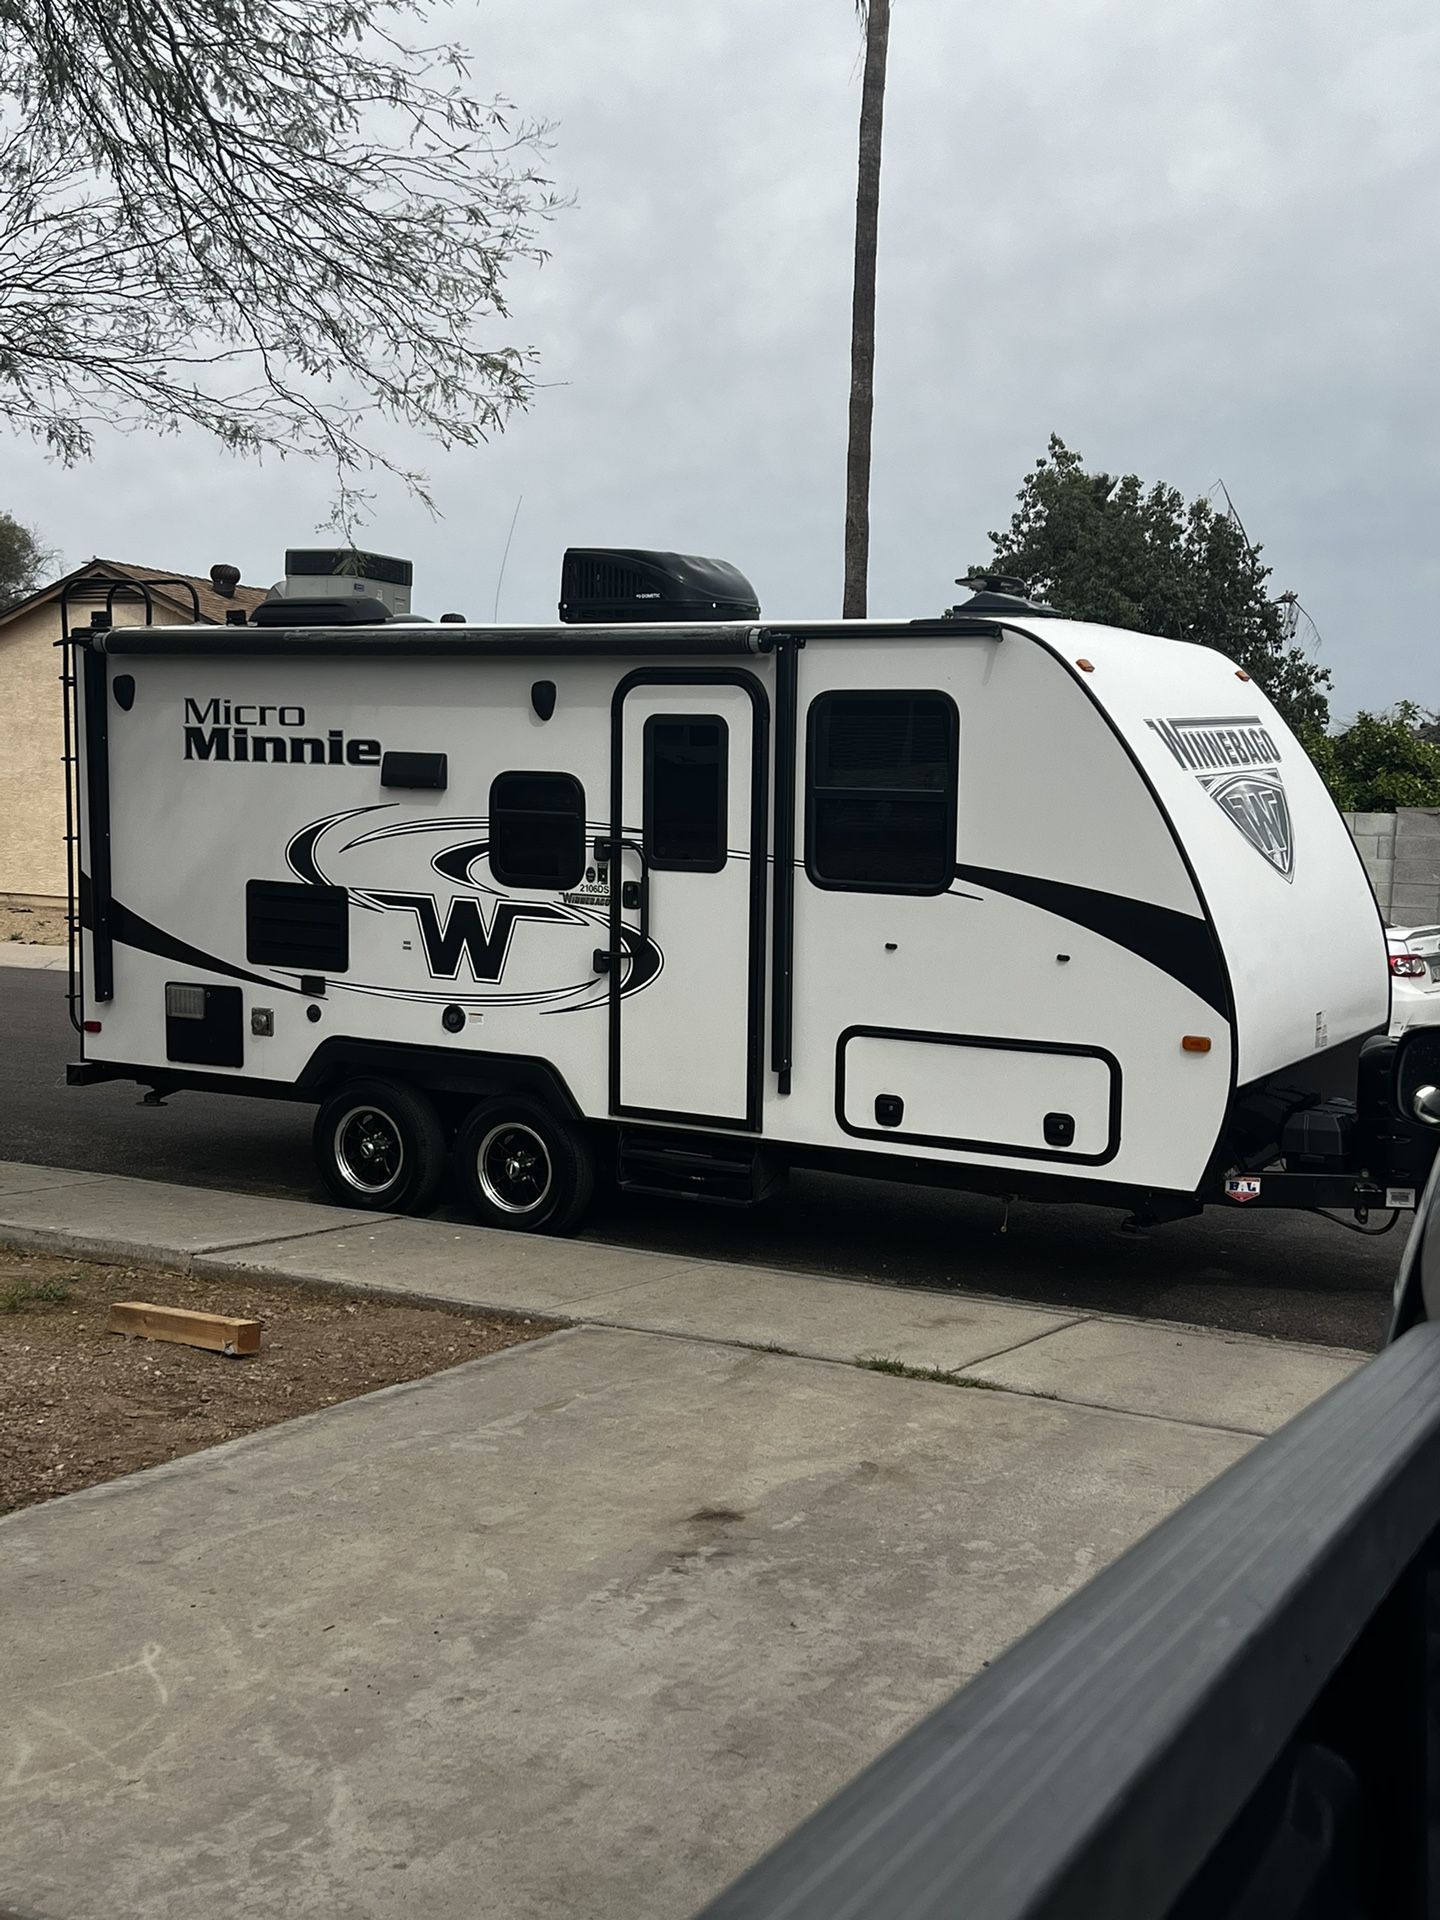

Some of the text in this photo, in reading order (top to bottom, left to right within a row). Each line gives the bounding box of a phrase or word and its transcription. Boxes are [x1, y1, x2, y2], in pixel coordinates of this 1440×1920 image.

[184, 697, 305, 726] Micro
[184, 725, 382, 766] Minnie
[1143, 715, 1282, 771] WINNEBAGO
[580, 883, 610, 894] 2106DS
